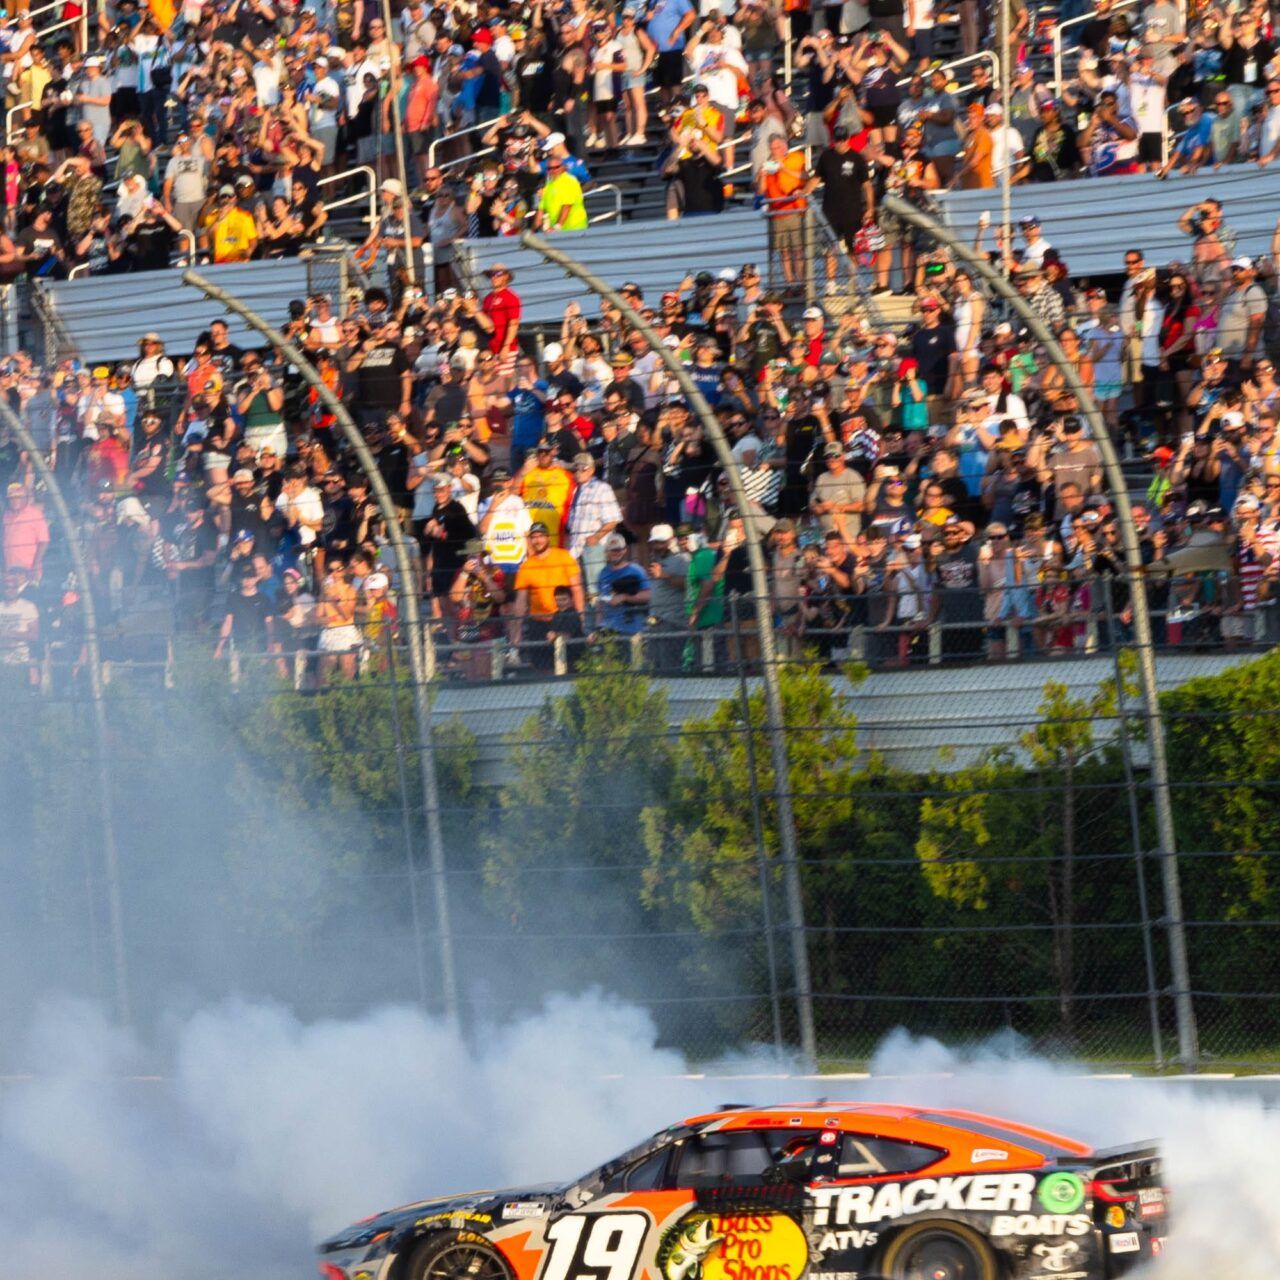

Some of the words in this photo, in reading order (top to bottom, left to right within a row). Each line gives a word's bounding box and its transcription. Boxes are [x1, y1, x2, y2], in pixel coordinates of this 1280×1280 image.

[804, 1173, 1037, 1226] TRACKER
[991, 1213, 1091, 1236] BOATS
[718, 1231, 762, 1259] Pro
[820, 1229, 880, 1252] ATVs
